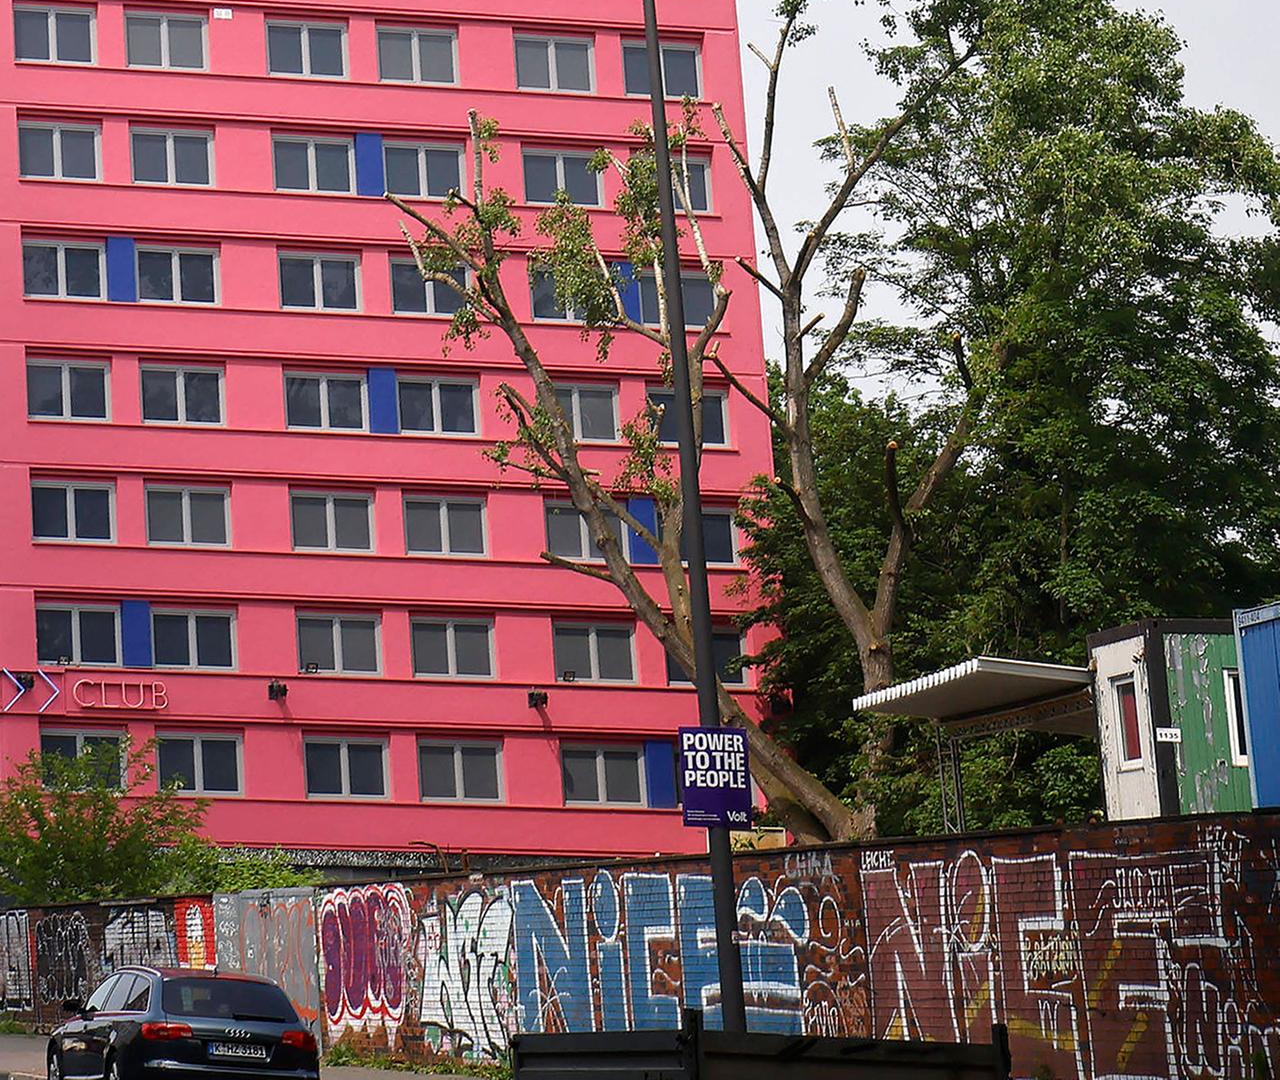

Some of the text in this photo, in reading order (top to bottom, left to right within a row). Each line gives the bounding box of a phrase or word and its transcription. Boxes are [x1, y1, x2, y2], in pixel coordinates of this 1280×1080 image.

[72, 678, 169, 710] CLUB
[682, 733, 744, 752] POWER
[683, 751, 745, 771] TO THE
[684, 770, 746, 789] PEOPLE
[726, 810, 748, 822] Volt
